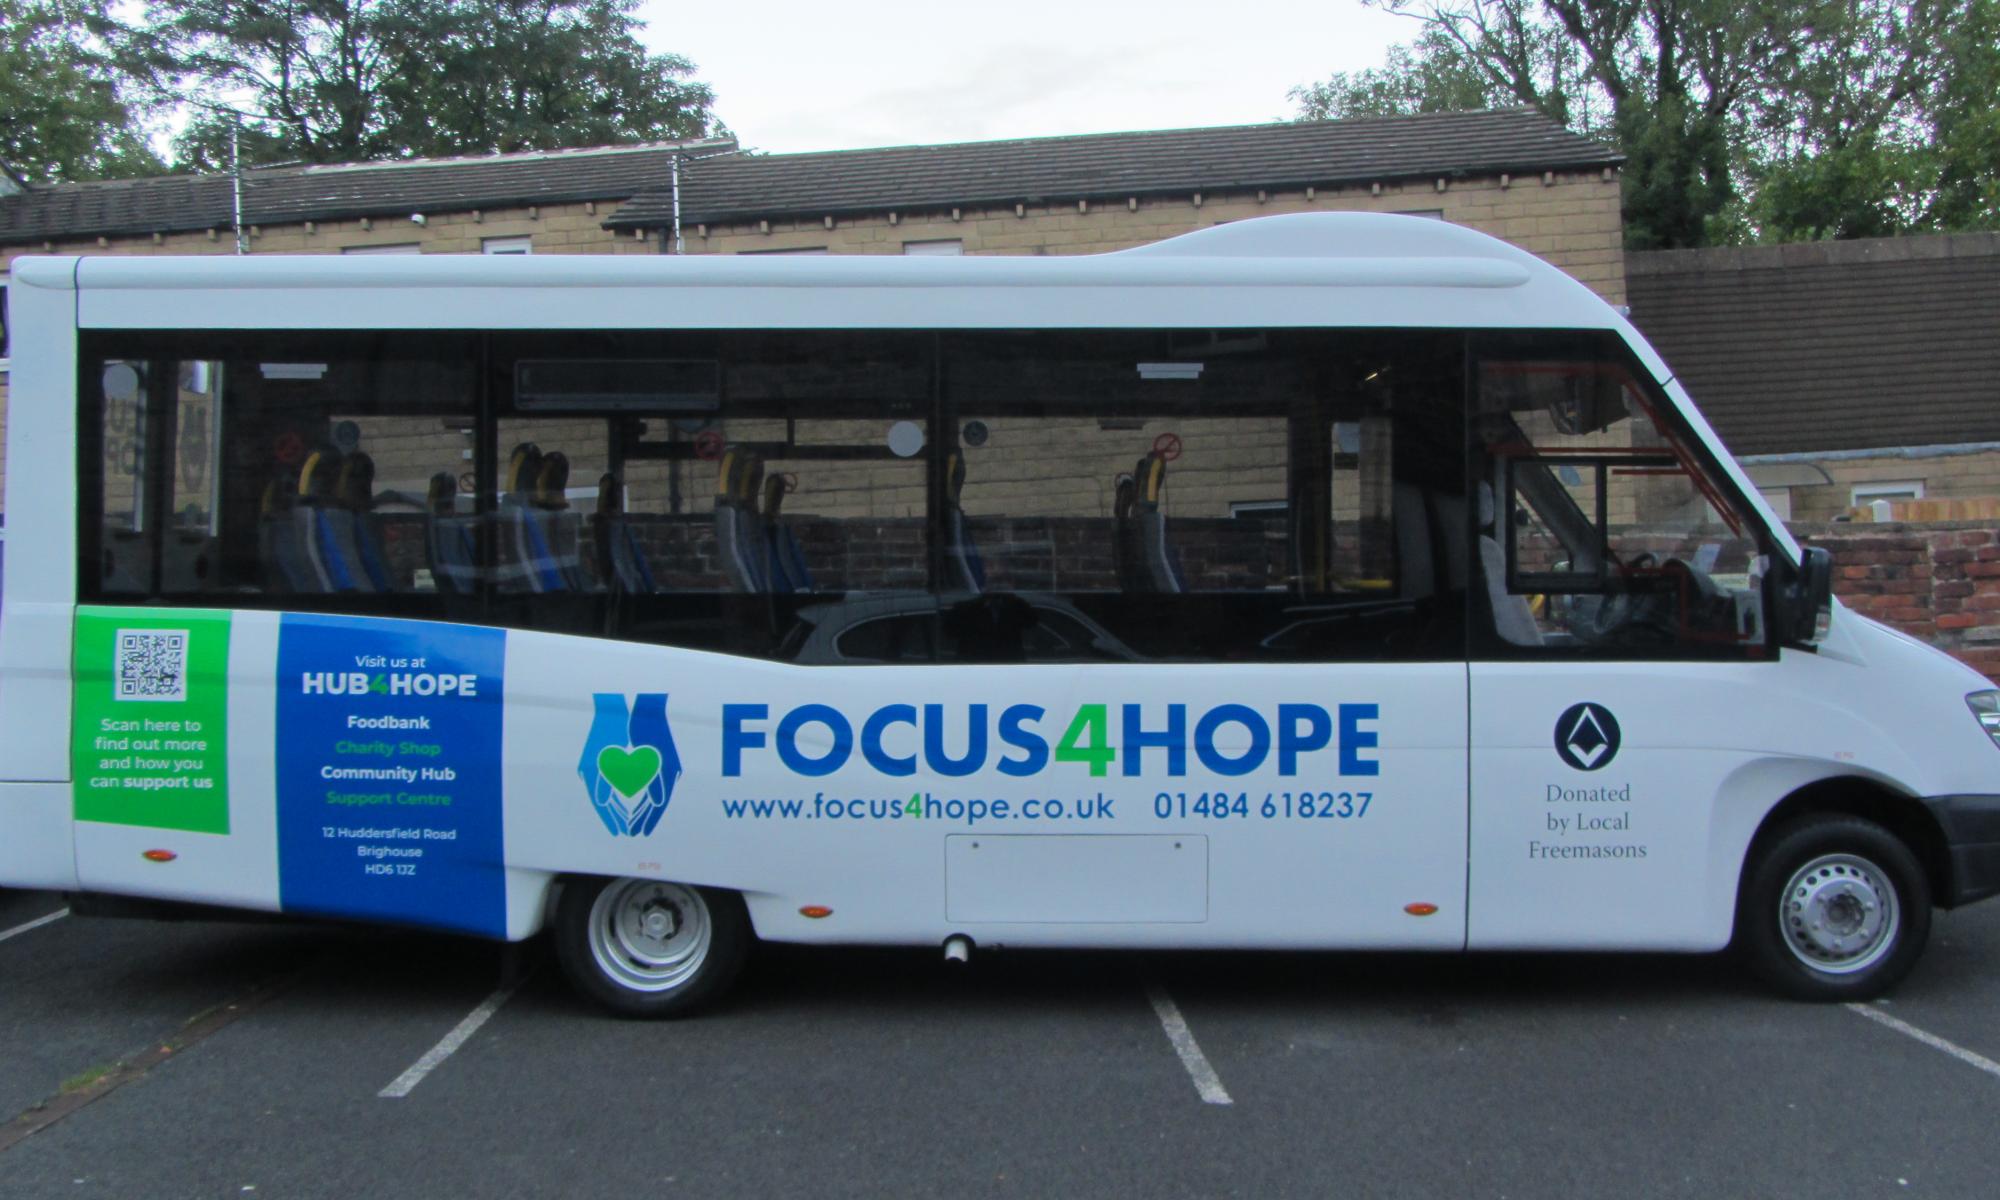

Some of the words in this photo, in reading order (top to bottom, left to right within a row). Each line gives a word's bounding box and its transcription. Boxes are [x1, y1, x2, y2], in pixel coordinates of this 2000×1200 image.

[355, 655, 387, 668] Visit
[390, 658, 408, 668] us
[410, 657, 426, 668] at
[302, 671, 477, 697] HUB4HOPE
[100, 718, 140, 732] Scan
[143, 718, 182, 732] here
[183, 719, 202, 733] to
[347, 715, 430, 730] Foodbank
[94, 736, 129, 751] find
[132, 739, 160, 751] out
[164, 739, 207, 751] more
[336, 740, 395, 757] Charity
[399, 740, 441, 757] Shop
[722, 704, 1379, 777] FOCUS4HOPE
[99, 756, 131, 770] and
[135, 756, 170, 769] how
[174, 759, 204, 773] you
[320, 765, 418, 784] Community
[421, 767, 456, 781] Hub
[89, 776, 120, 788] can
[122, 775, 190, 791] support
[191, 777, 214, 789] us
[326, 791, 392, 806] Support
[396, 792, 451, 805] Centre
[1546, 783, 1630, 803] Donated
[721, 792, 1115, 826] www.focus4hope.co.uk
[1154, 792, 1249, 819] 01484
[1260, 791, 1373, 819] 618237
[1547, 811, 1570, 836] by
[1577, 811, 1629, 831] Local
[322, 826, 336, 838] 12
[337, 827, 421, 840] Huddersfield
[423, 828, 457, 840] Road
[357, 845, 423, 859] Brighouse
[1529, 840, 1648, 859] Freemasons
[364, 863, 395, 876] HD6
